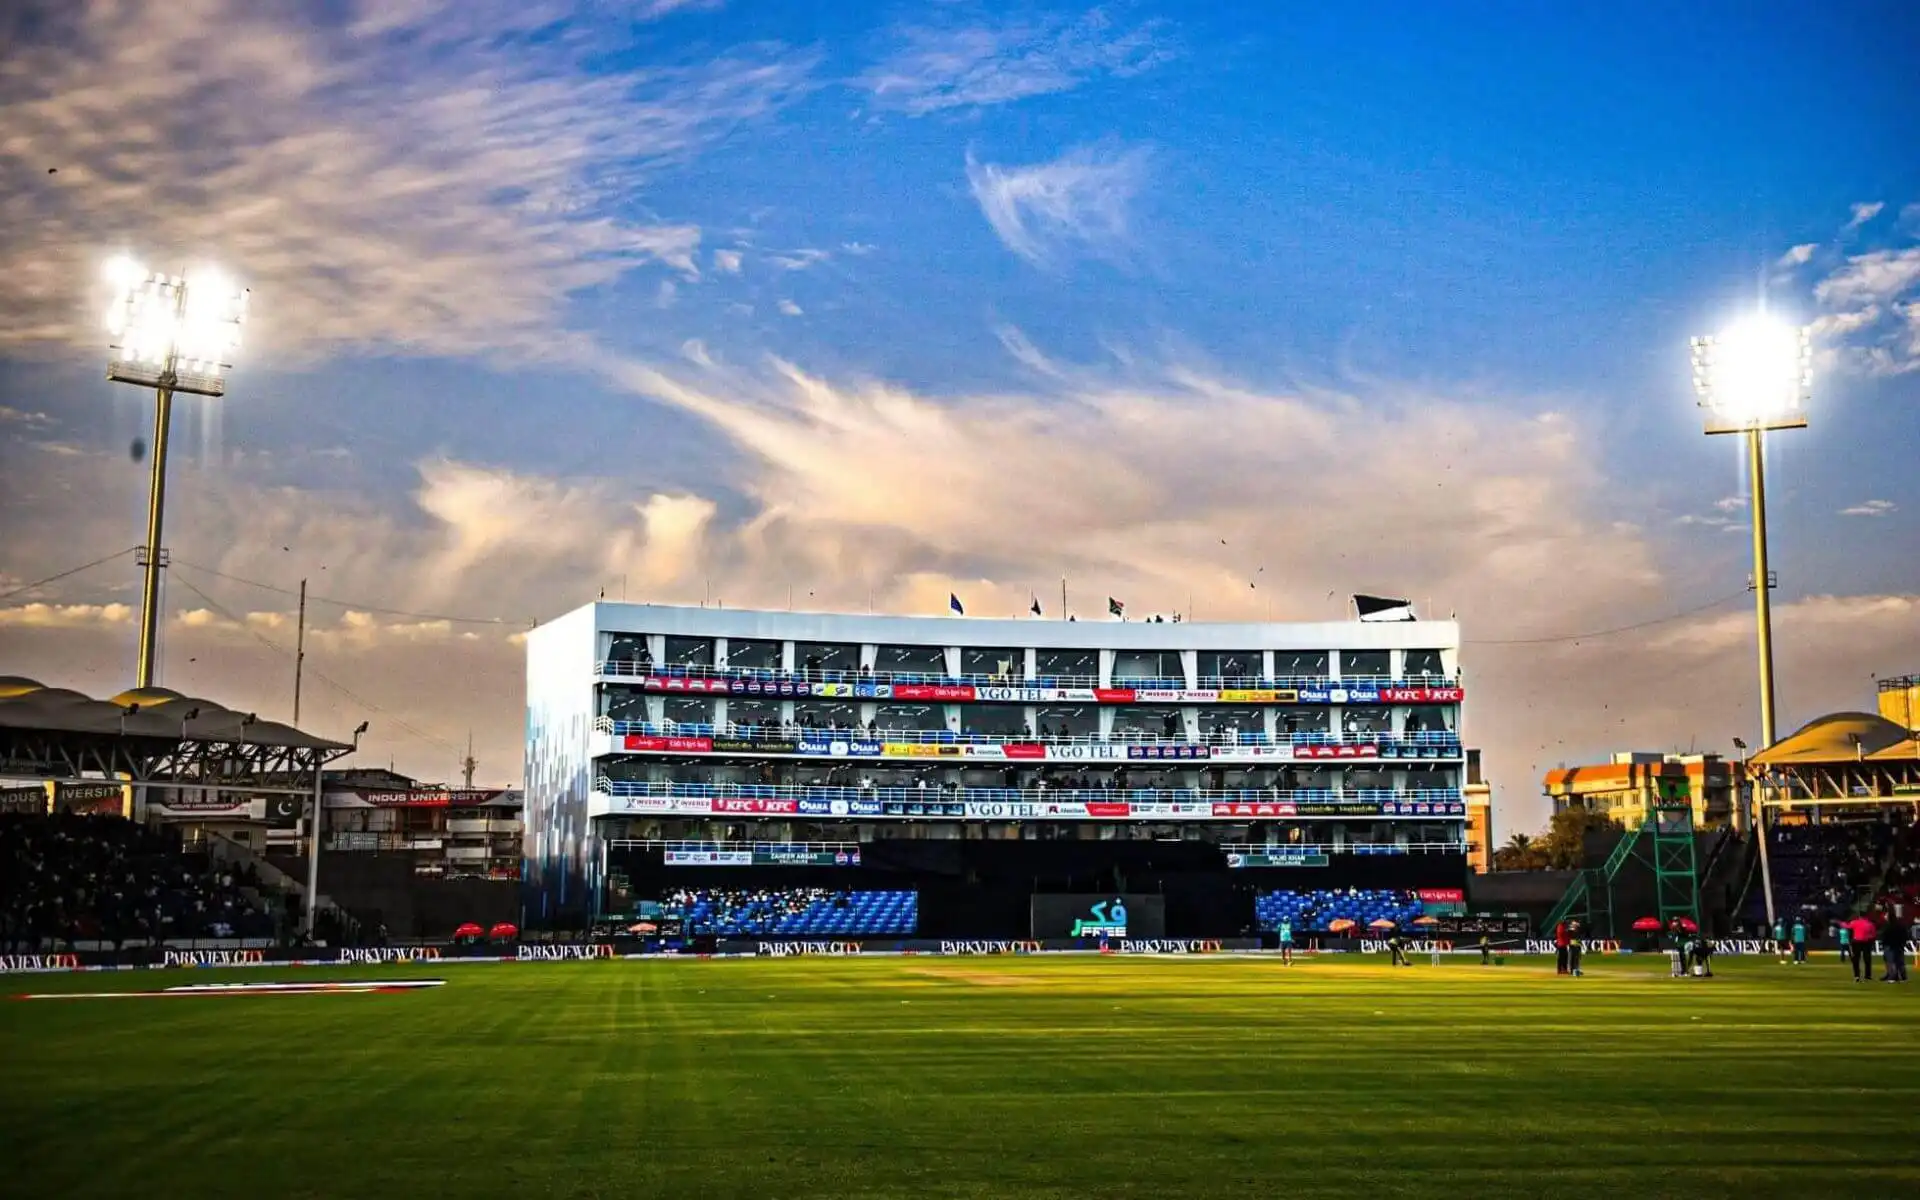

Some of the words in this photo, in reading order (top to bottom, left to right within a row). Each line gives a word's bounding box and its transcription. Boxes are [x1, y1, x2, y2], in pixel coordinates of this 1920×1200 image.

[980, 688, 1011, 701] VGO
[1016, 688, 1047, 701] TEL
[1394, 691, 1420, 700] KFC
[1432, 691, 1458, 701] KFC
[799, 742, 827, 753] OSAKA
[851, 743, 879, 753] OSAKA
[1050, 747, 1083, 759] VGO
[1087, 747, 1118, 759] TEL
[368, 794, 406, 802] INDUS
[411, 792, 489, 802] UNIVERSITY
[725, 800, 753, 811] KFC
[765, 801, 793, 812] KFC
[799, 800, 827, 811] OSAKA
[851, 801, 880, 811] OSAKA
[969, 804, 1003, 817] VGO
[1007, 804, 1039, 817] TEL
[585, 944, 615, 959] CITY
[830, 941, 863, 955] CITY
[1010, 940, 1043, 954] CITY
[1190, 939, 1223, 953] CITY
[1424, 939, 1454, 953] CITY
[1591, 939, 1622, 954] CITY
[233, 950, 265, 964] CITY
[409, 947, 441, 960] CITY
[46, 954, 79, 969] CITY
